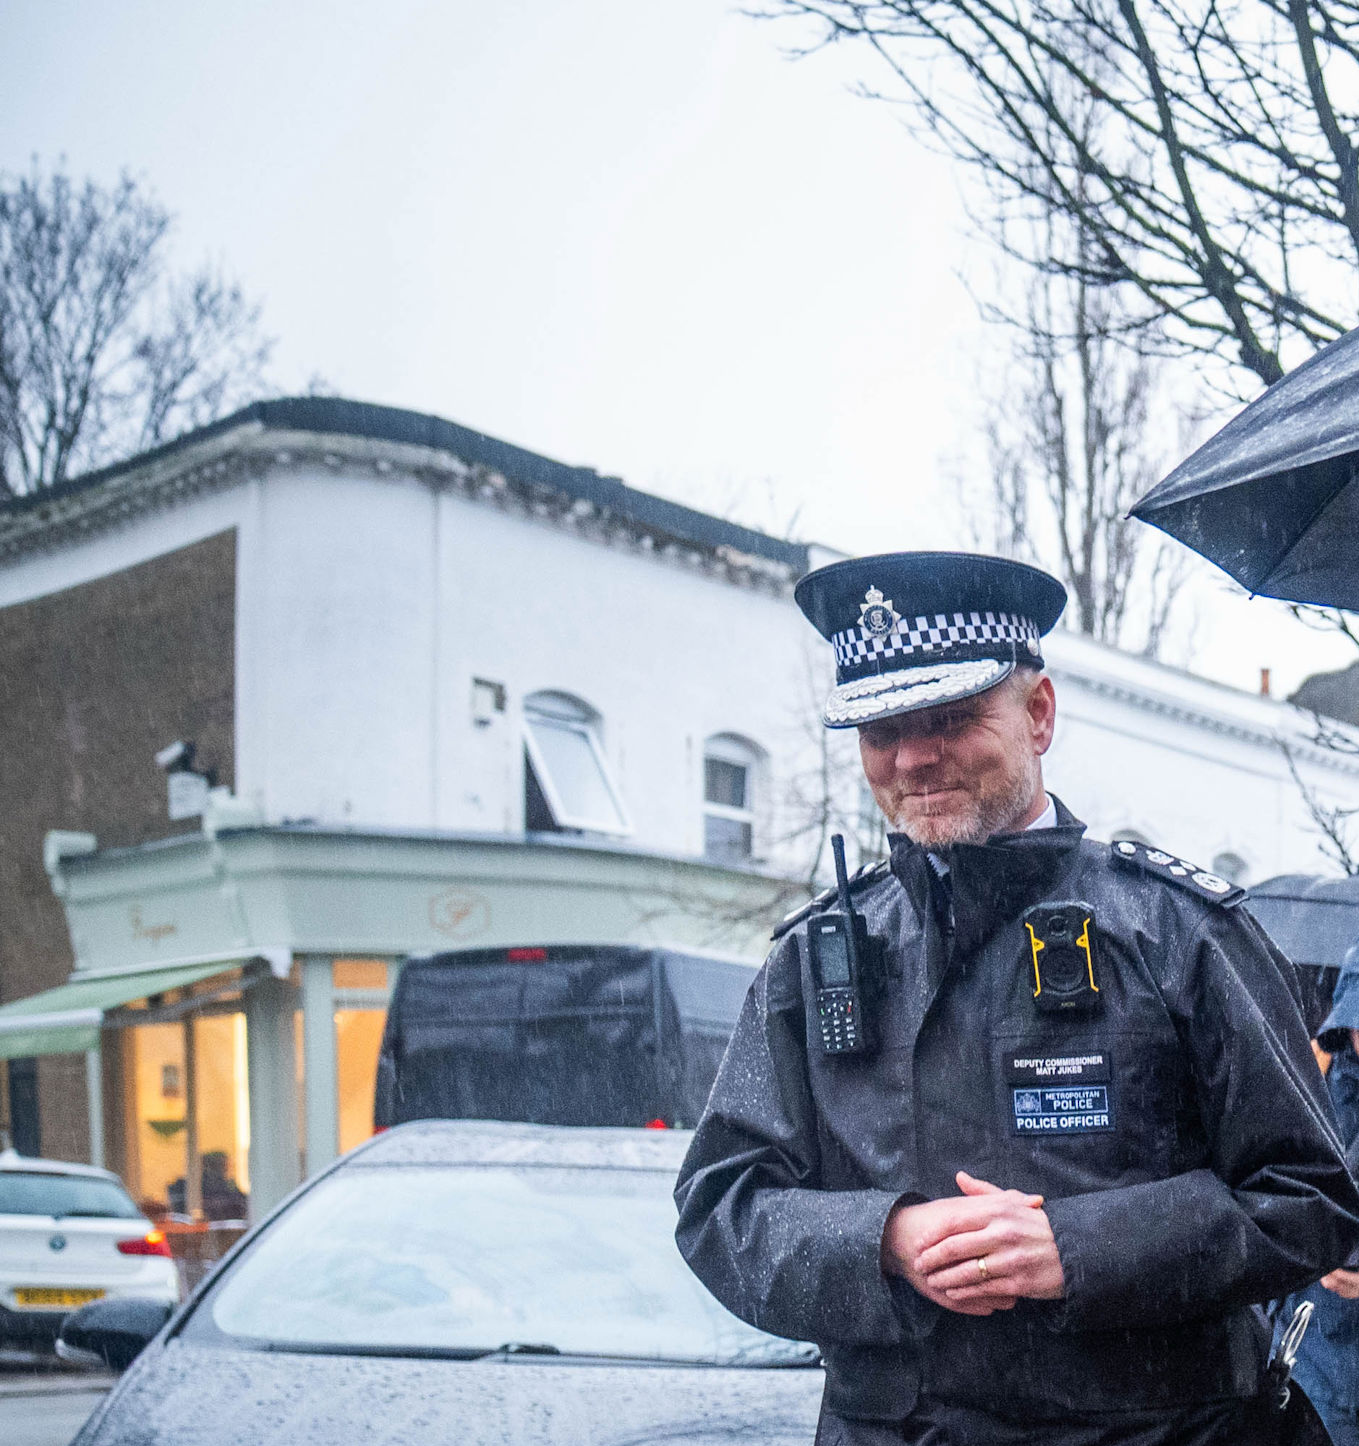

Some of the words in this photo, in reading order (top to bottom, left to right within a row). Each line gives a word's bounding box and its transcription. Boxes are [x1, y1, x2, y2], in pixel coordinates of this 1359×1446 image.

[1014, 1059, 1044, 1068] DEPUTY
[1045, 1056, 1103, 1066] COMMISSIONER
[1036, 1067, 1057, 1075] MATT
[1057, 1066, 1083, 1075] JUKES
[1045, 1091, 1100, 1100] METROPOLITAN
[1053, 1099, 1093, 1110] POLICE
[1017, 1117, 1058, 1129] POLICE
[1060, 1115, 1109, 1128] OFFICER
